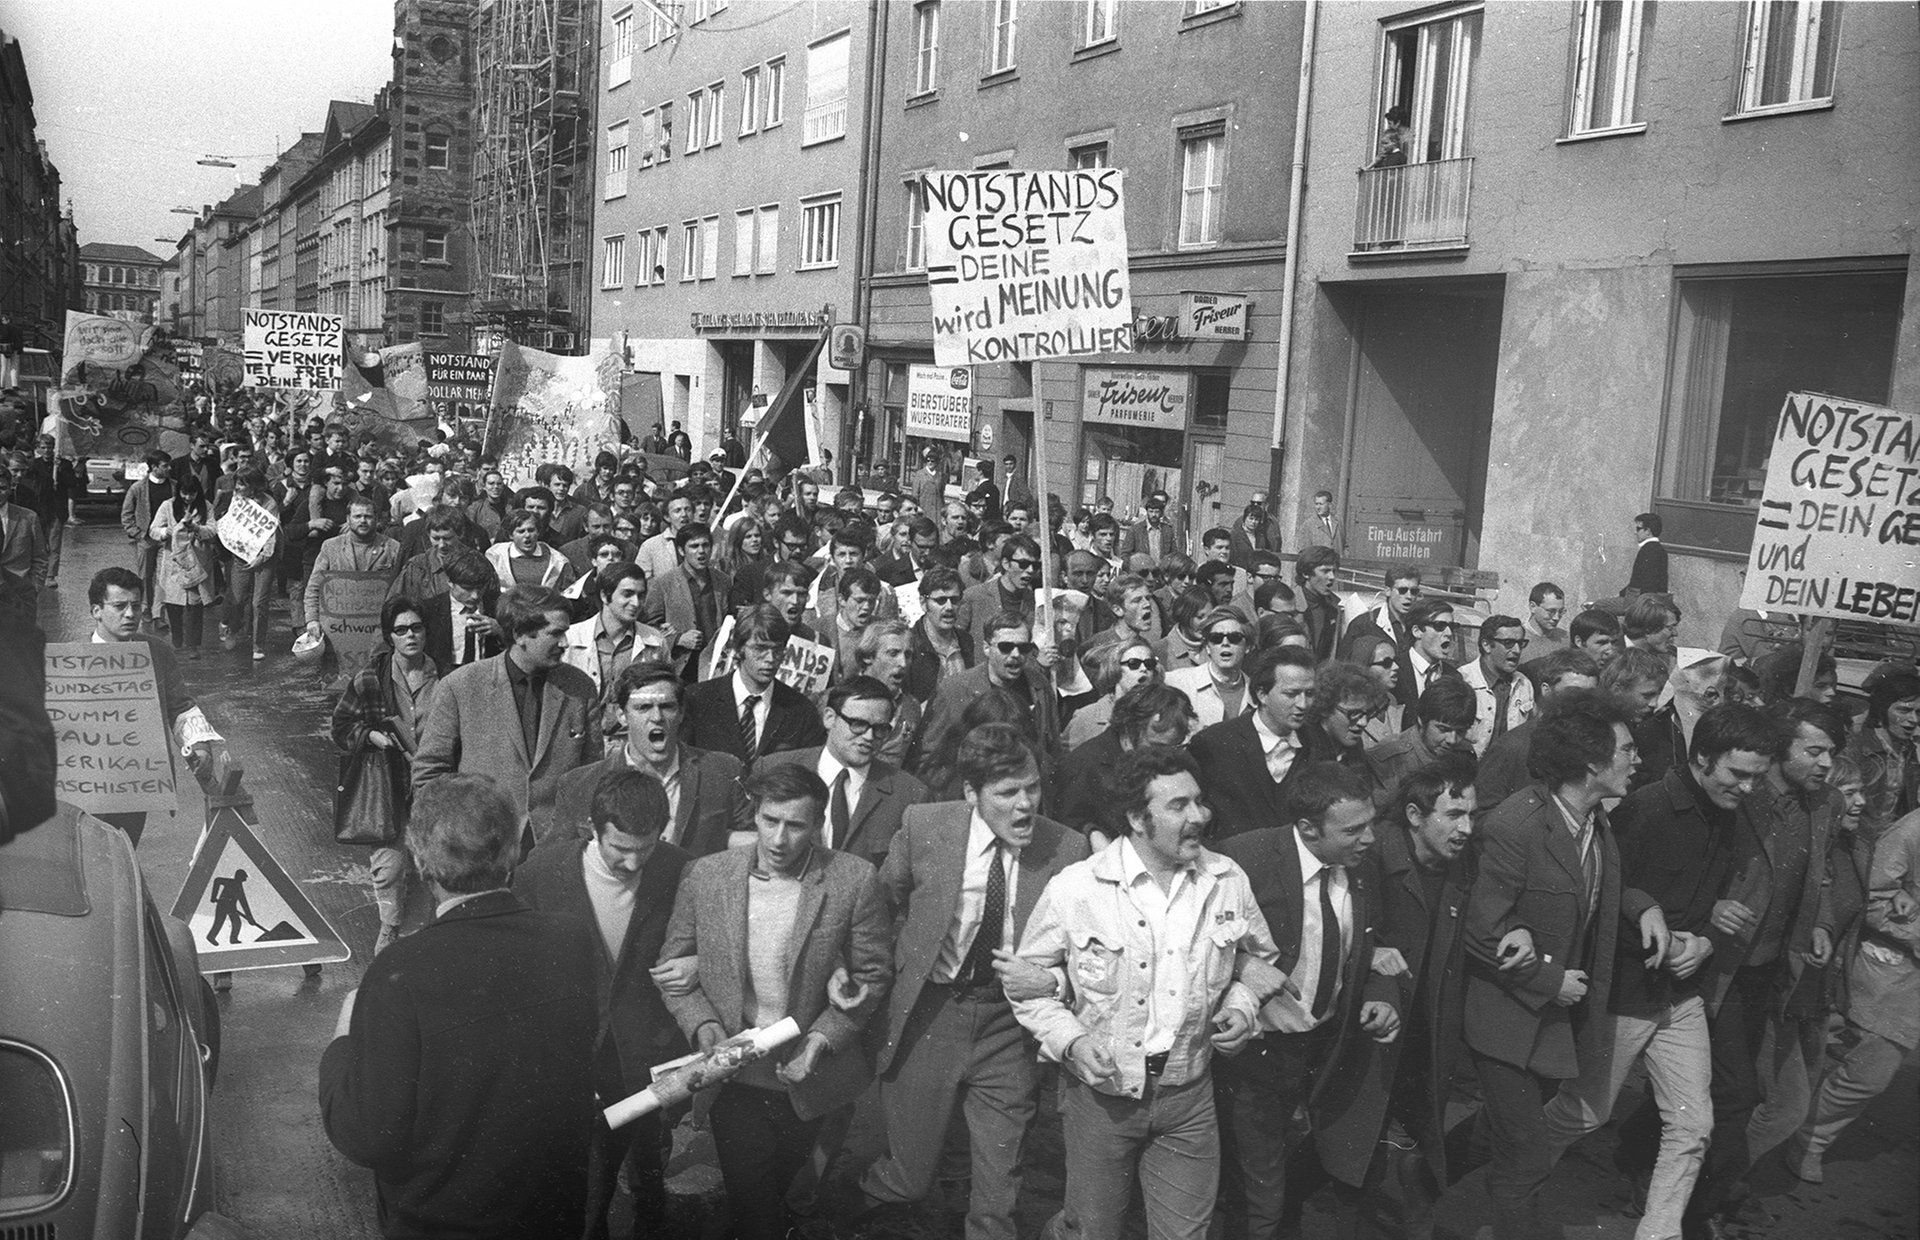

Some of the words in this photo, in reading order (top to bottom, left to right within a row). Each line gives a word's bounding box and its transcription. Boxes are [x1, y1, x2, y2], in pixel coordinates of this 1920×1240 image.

[920, 170, 1119, 213] NOTSTANDS
[949, 211, 1094, 250] GESETZ
[961, 249, 1050, 281] DEINE
[935, 296, 992, 335] wird
[999, 269, 1123, 325] MEINUNG
[246, 311, 341, 332] NOTSTANDS
[1193, 303, 1242, 331] Friseur
[265, 331, 338, 348] GESETZ
[968, 322, 1134, 363] KONTROLLIERT
[245, 363, 275, 377] TET
[295, 365, 334, 379] FREI
[268, 350, 341, 367] VERNICH
[430, 354, 490, 370] NOTSTAND
[255, 376, 302, 388] DEINE
[309, 376, 341, 390] HEIT
[432, 367, 448, 380] FÜR
[450, 369, 464, 380] EIN
[466, 371, 486, 381] PAAR
[1098, 380, 1174, 416] Friseur
[1779, 396, 1920, 465] NOTSTA
[1797, 500, 1876, 537] DEIN
[1376, 542, 1431, 558] freihalten
[1757, 534, 1812, 571] und
[1765, 575, 1830, 608] DEIN
[46, 708, 139, 723] DUMME
[56, 729, 141, 746] AULE
